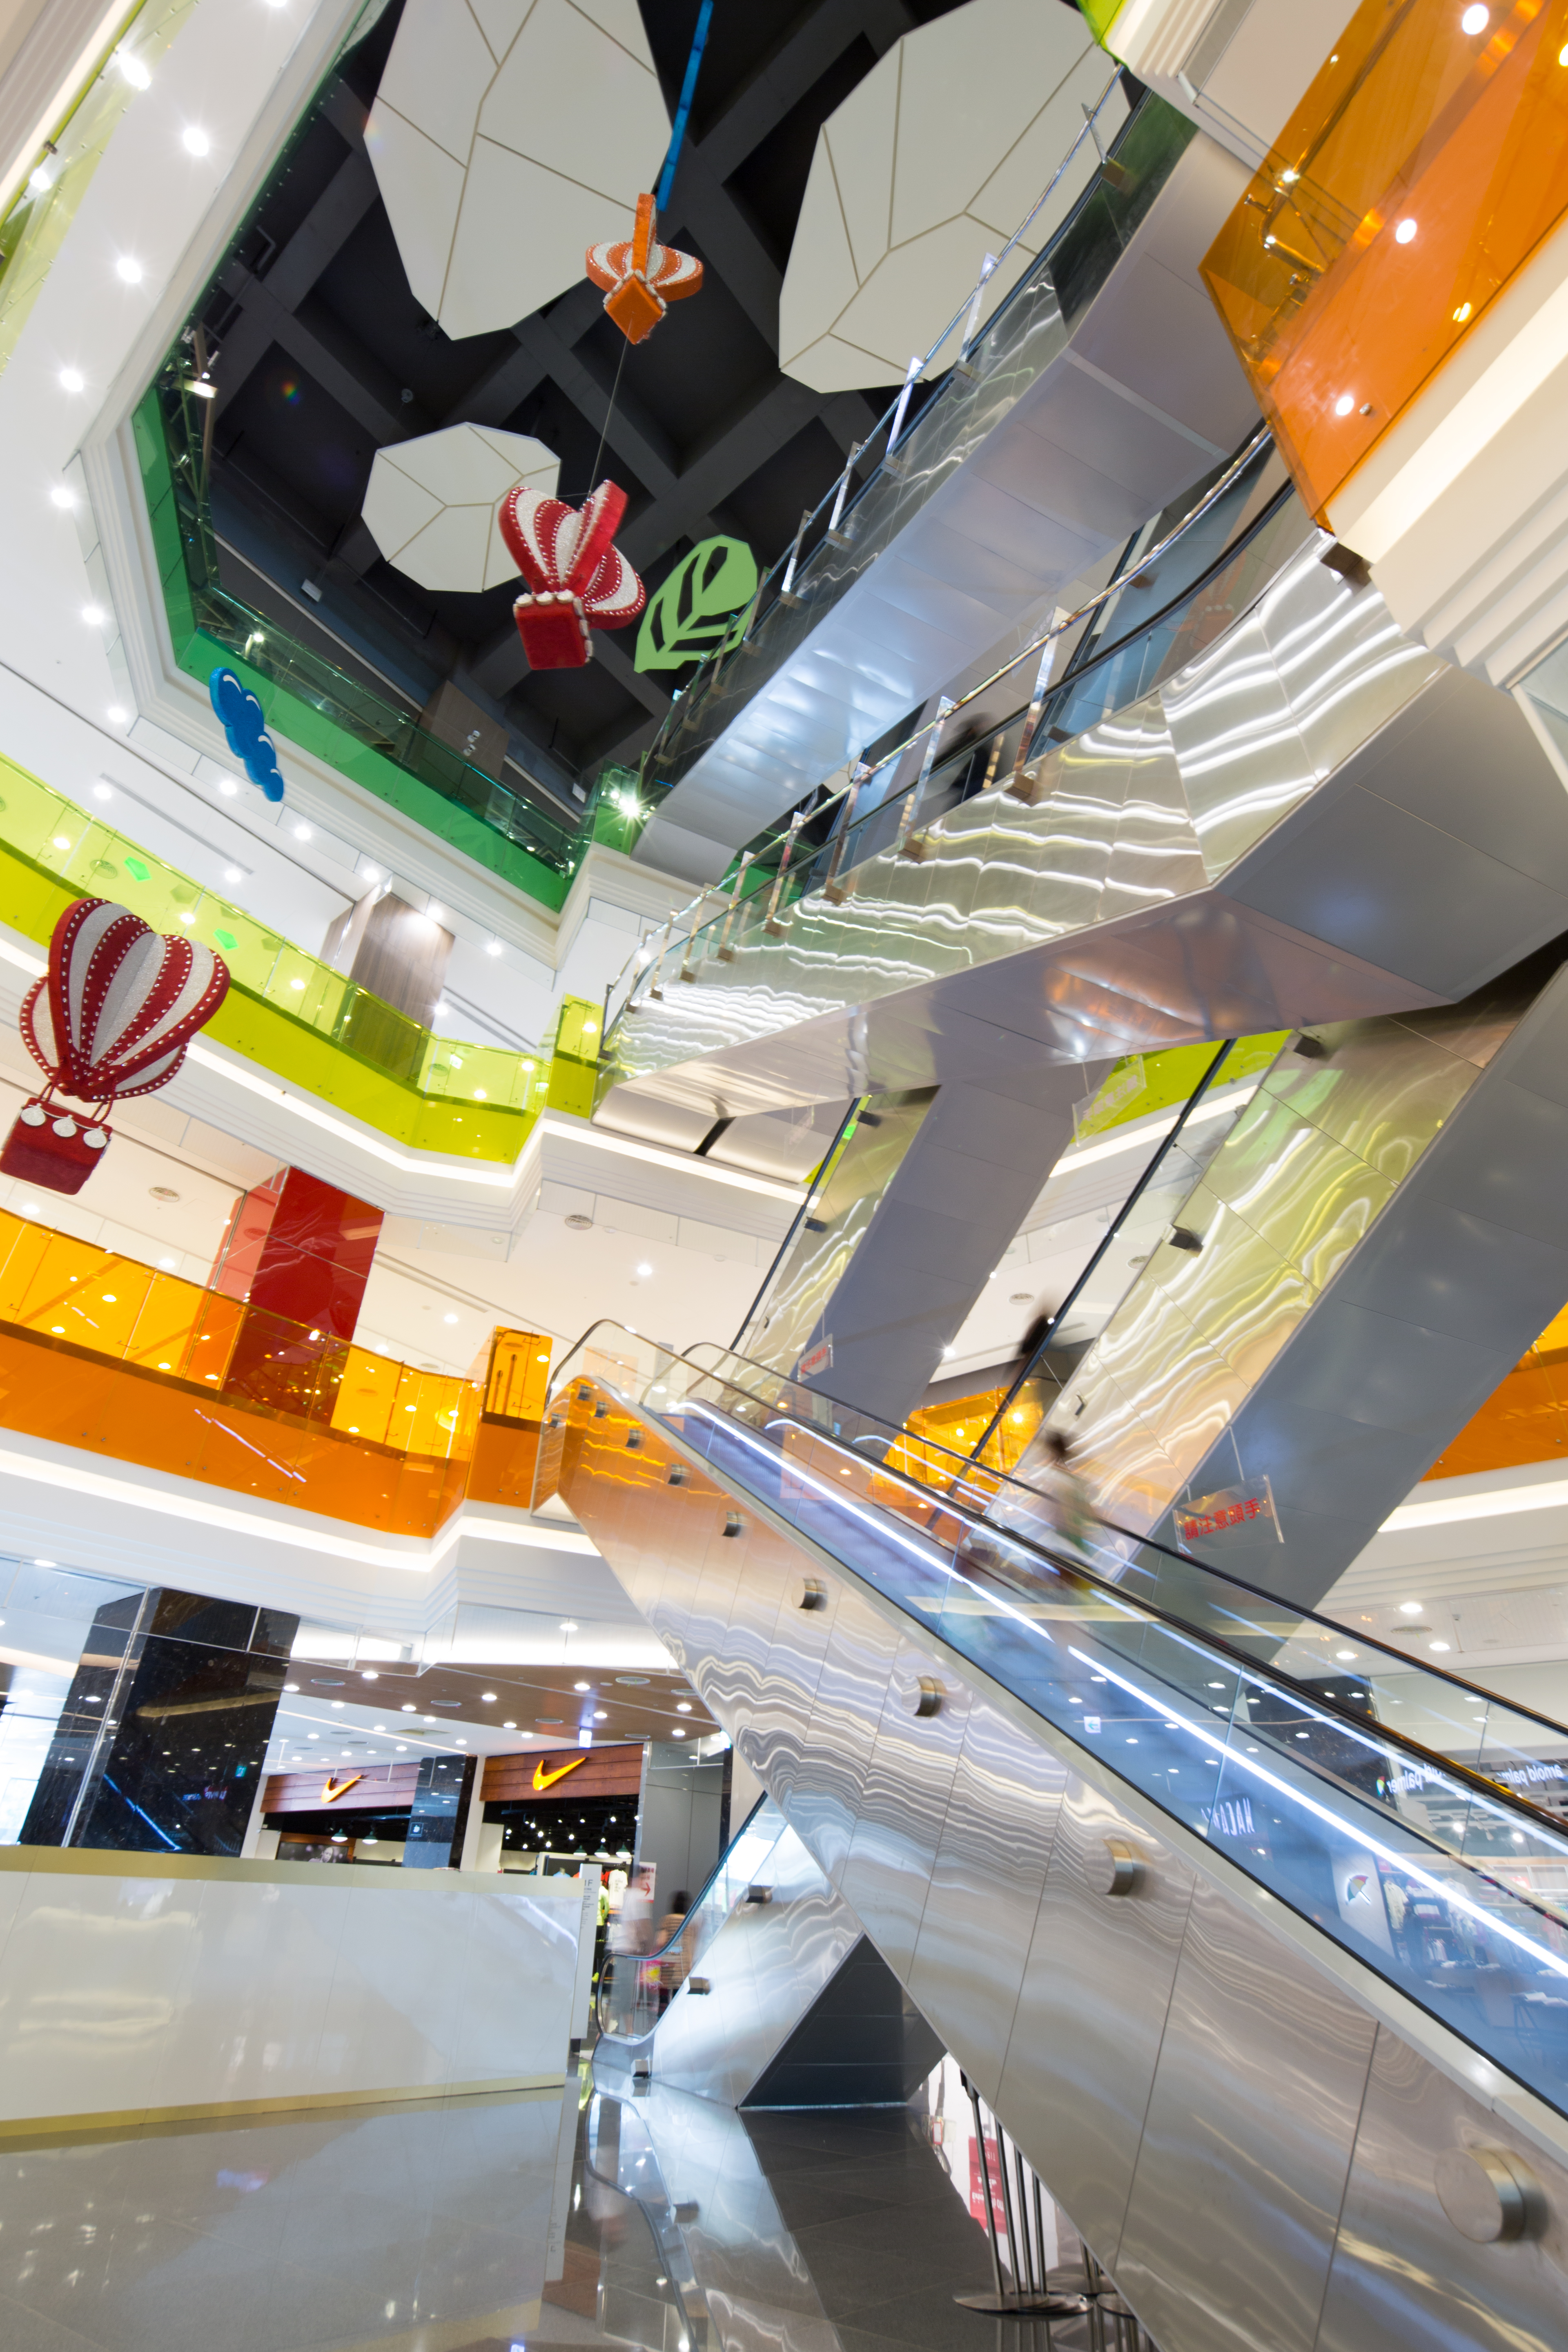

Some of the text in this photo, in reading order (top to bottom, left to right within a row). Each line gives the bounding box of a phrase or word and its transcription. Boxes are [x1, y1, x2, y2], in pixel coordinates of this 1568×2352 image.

[1184, 1497, 1261, 1540] 請注意頭手
